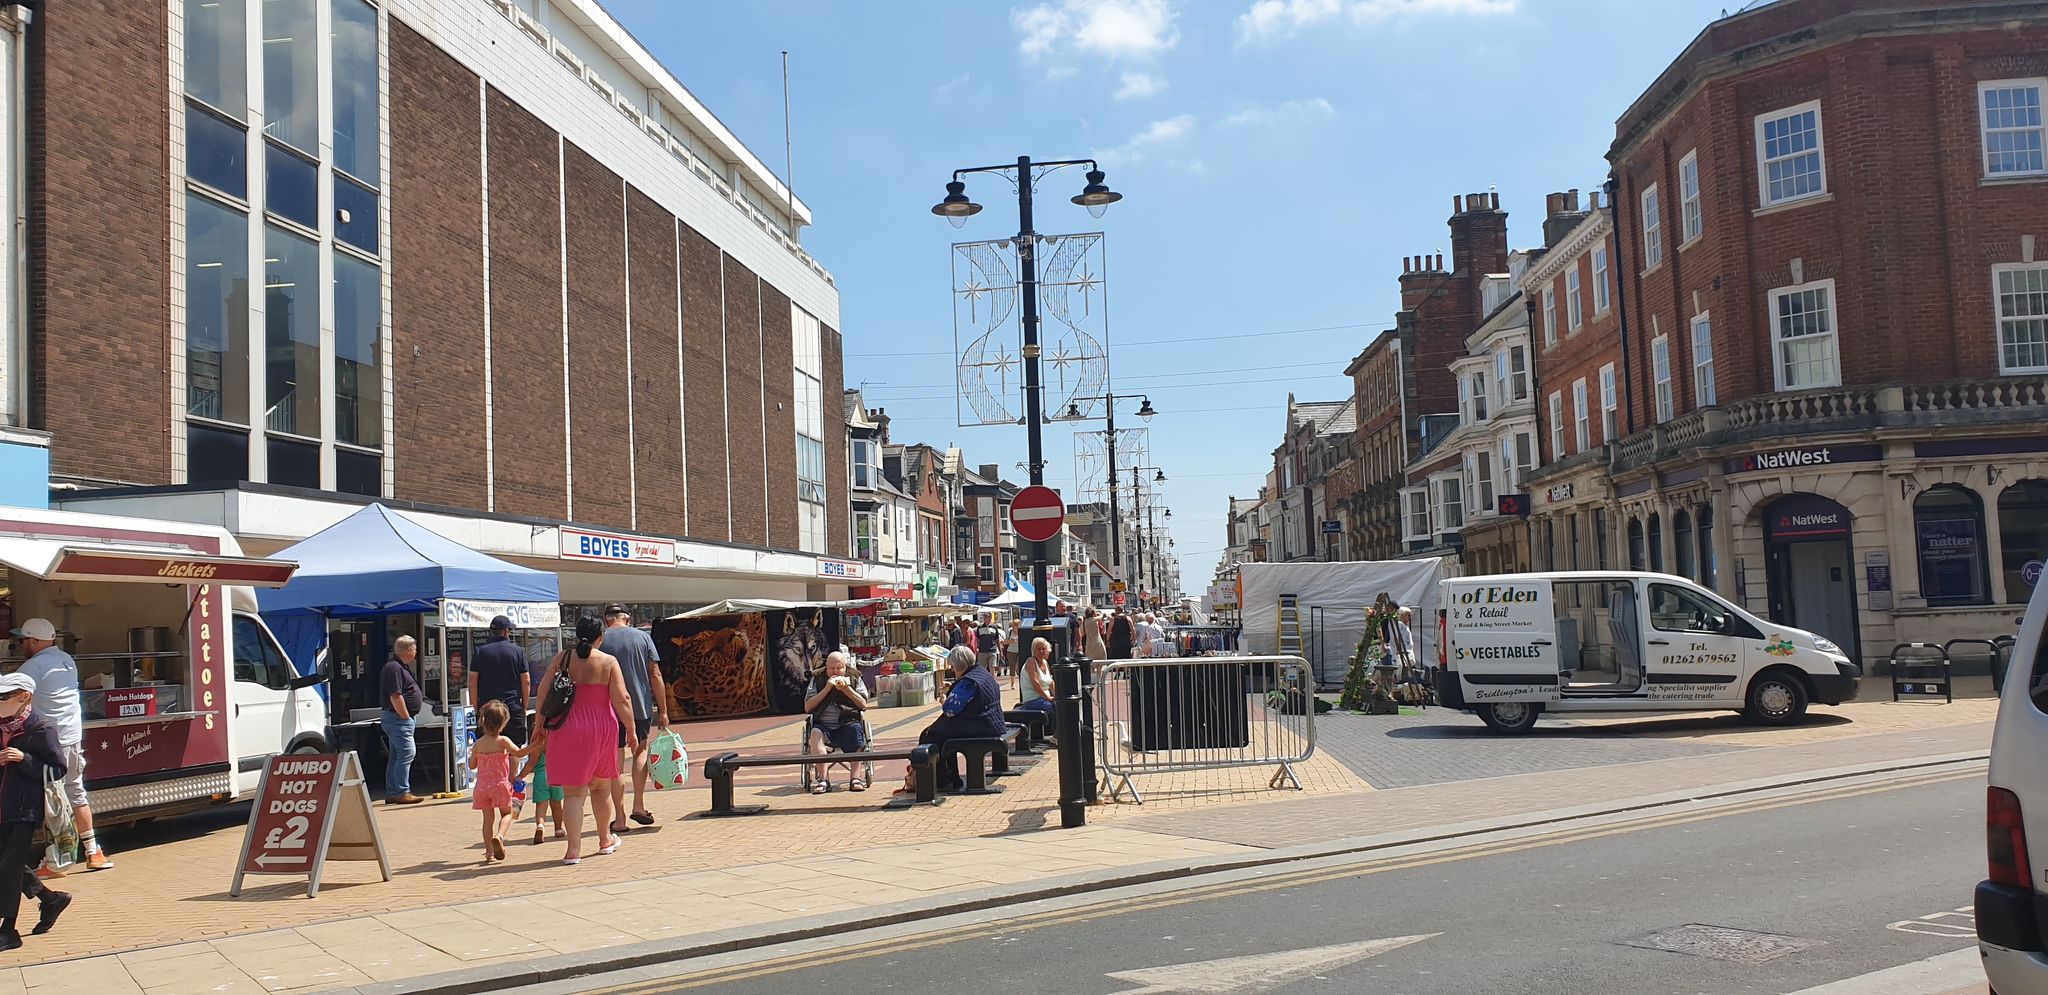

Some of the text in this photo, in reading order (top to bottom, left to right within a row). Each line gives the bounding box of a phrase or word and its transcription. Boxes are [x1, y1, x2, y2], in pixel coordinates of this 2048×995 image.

[1757, 448, 1831, 469] NatWest
[1792, 513, 1838, 526] NatWest
[580, 536, 630, 558] BOYES
[1929, 536, 1974, 547] natter
[157, 560, 217, 578] Jackets
[824, 562, 845, 575] BOYES
[1461, 586, 1538, 605] of Eden
[445, 602, 470, 623] EYG
[506, 605, 529, 624] EYG
[1465, 608, 1473, 618] &
[1479, 607, 1509, 618] Retail
[1470, 645, 1540, 660] VEGETABLES
[1689, 643, 1708, 651] Tel.
[1662, 653, 1737, 664] 01262 679562
[107, 692, 154, 702] Jumbo Hotdogs
[1475, 685, 1534, 699] Bridlington's
[1658, 684, 1696, 692] Specialist
[273, 760, 332, 776] JUMBO
[280, 780, 318, 795] HOT
[269, 799, 318, 814] DOGS
[263, 815, 310, 849] £2
